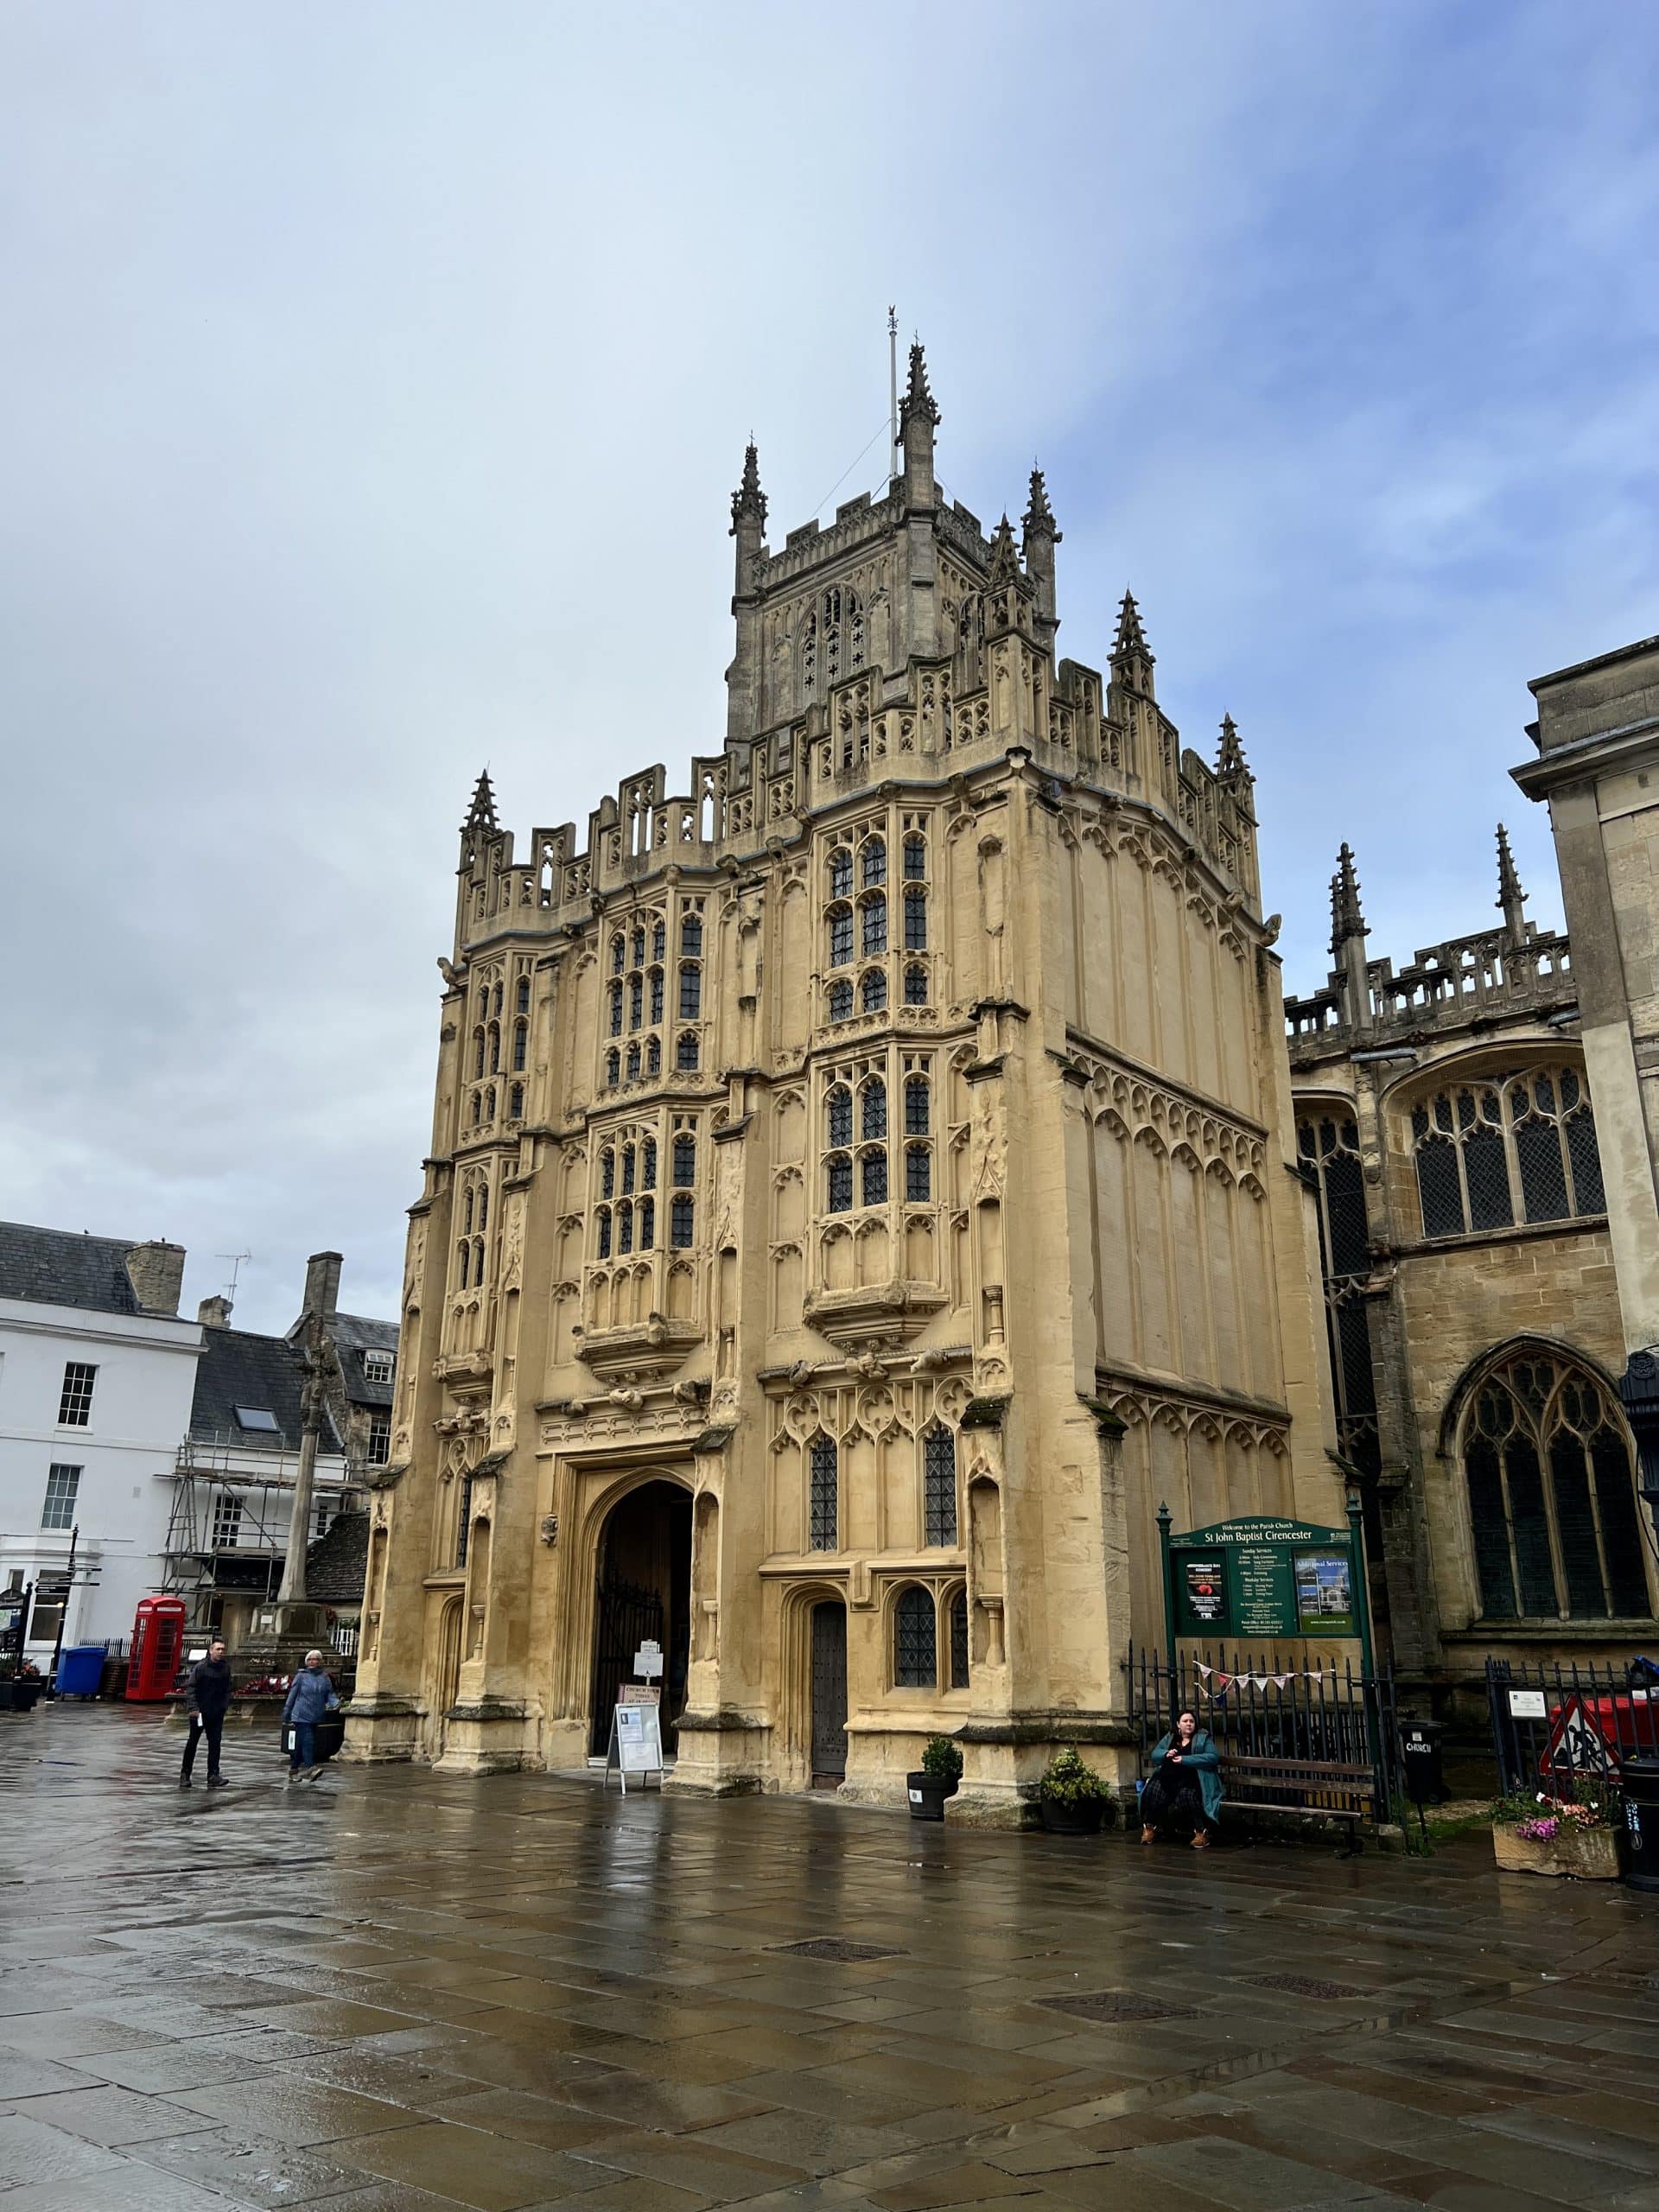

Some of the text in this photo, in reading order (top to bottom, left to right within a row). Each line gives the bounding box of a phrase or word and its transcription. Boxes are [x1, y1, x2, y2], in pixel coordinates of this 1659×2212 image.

[1205, 1530, 1312, 1543] St John Baptist Cirencester
